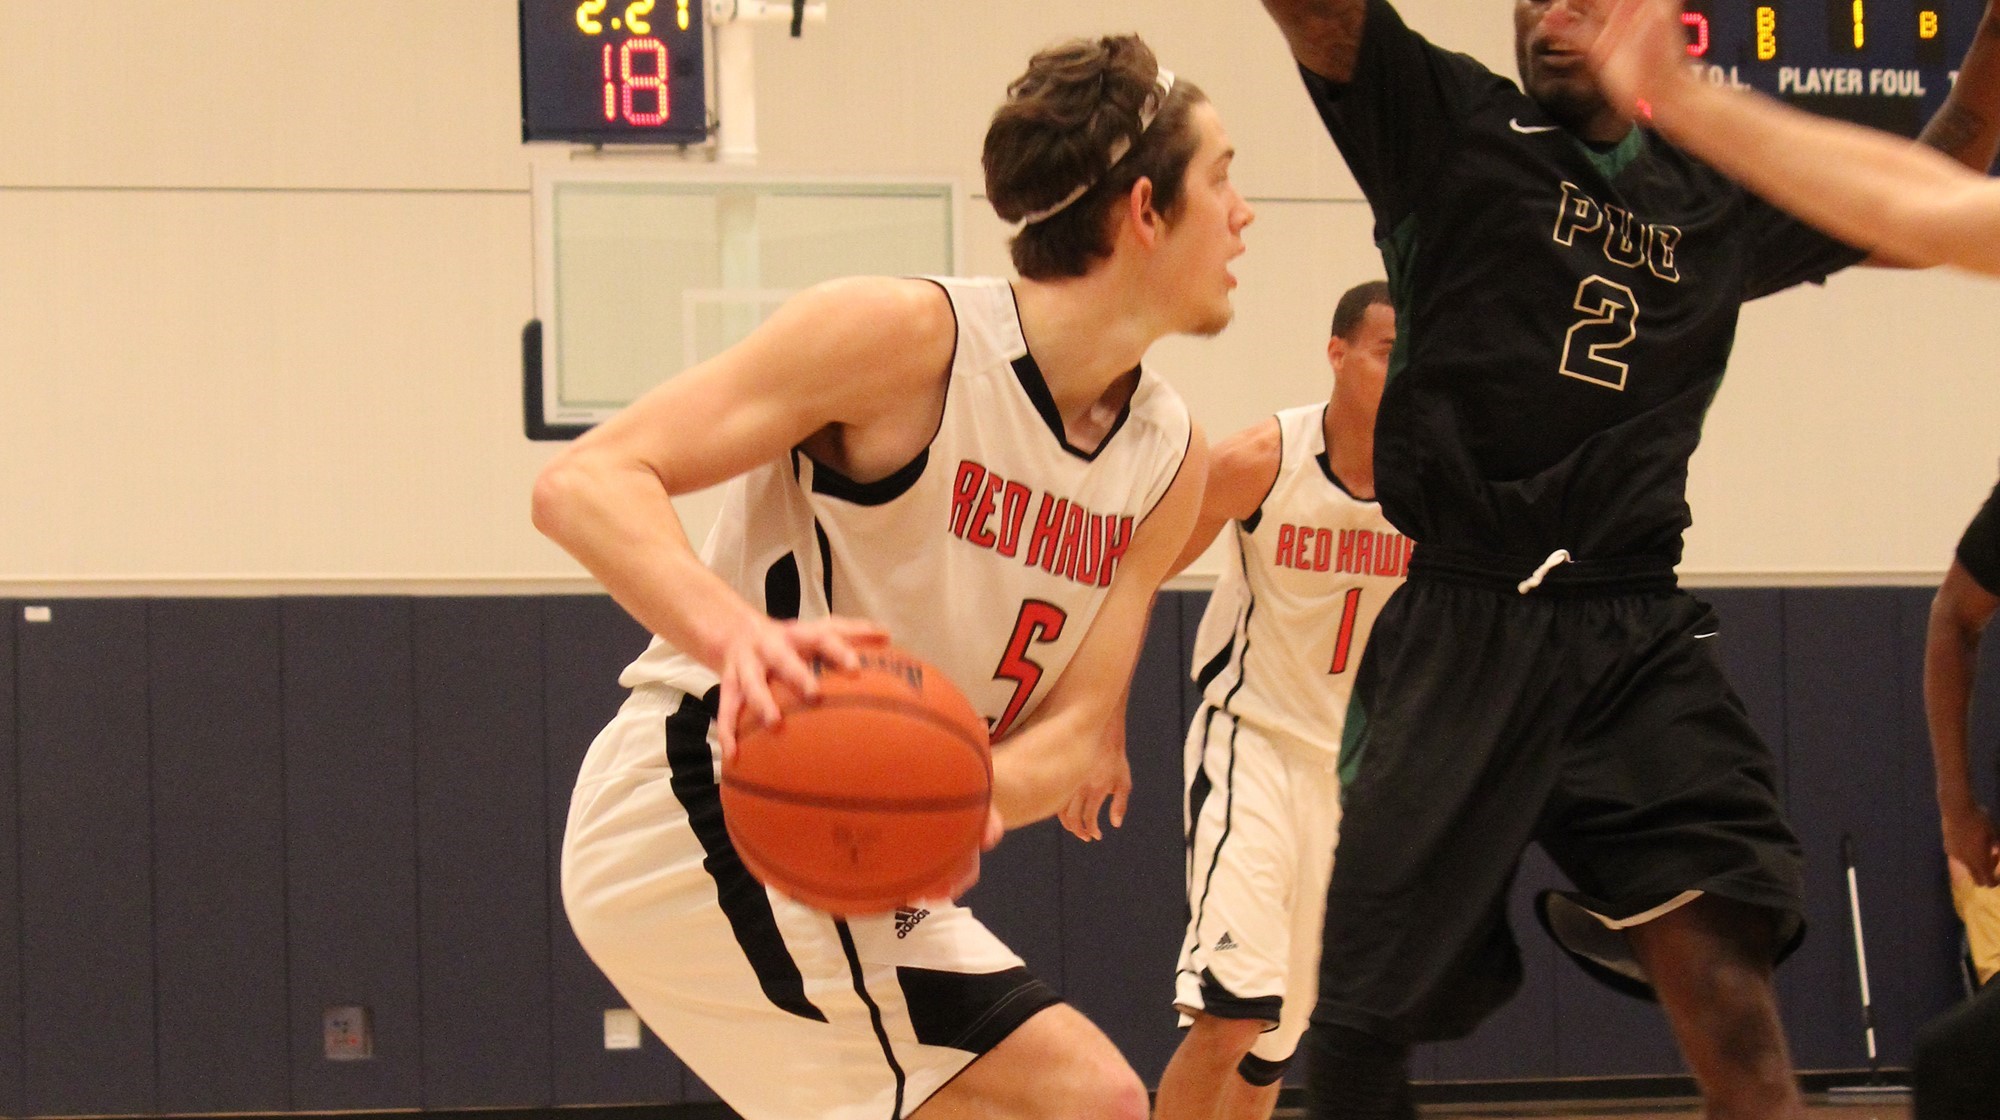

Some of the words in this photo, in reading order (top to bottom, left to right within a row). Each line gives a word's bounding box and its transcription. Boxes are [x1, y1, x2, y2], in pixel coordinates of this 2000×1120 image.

[603, 37, 670, 126] 18
[1778, 66, 1863, 94] PLAYER
[1869, 67, 1926, 97] FOUL
[1553, 180, 1682, 283] PUC
[1559, 274, 1640, 391] 2
[949, 460, 1032, 558] RED
[1274, 523, 1333, 572] RED
[988, 598, 1068, 747] 5
[1328, 587, 1363, 674] 1
[897, 908, 931, 940] adidas
